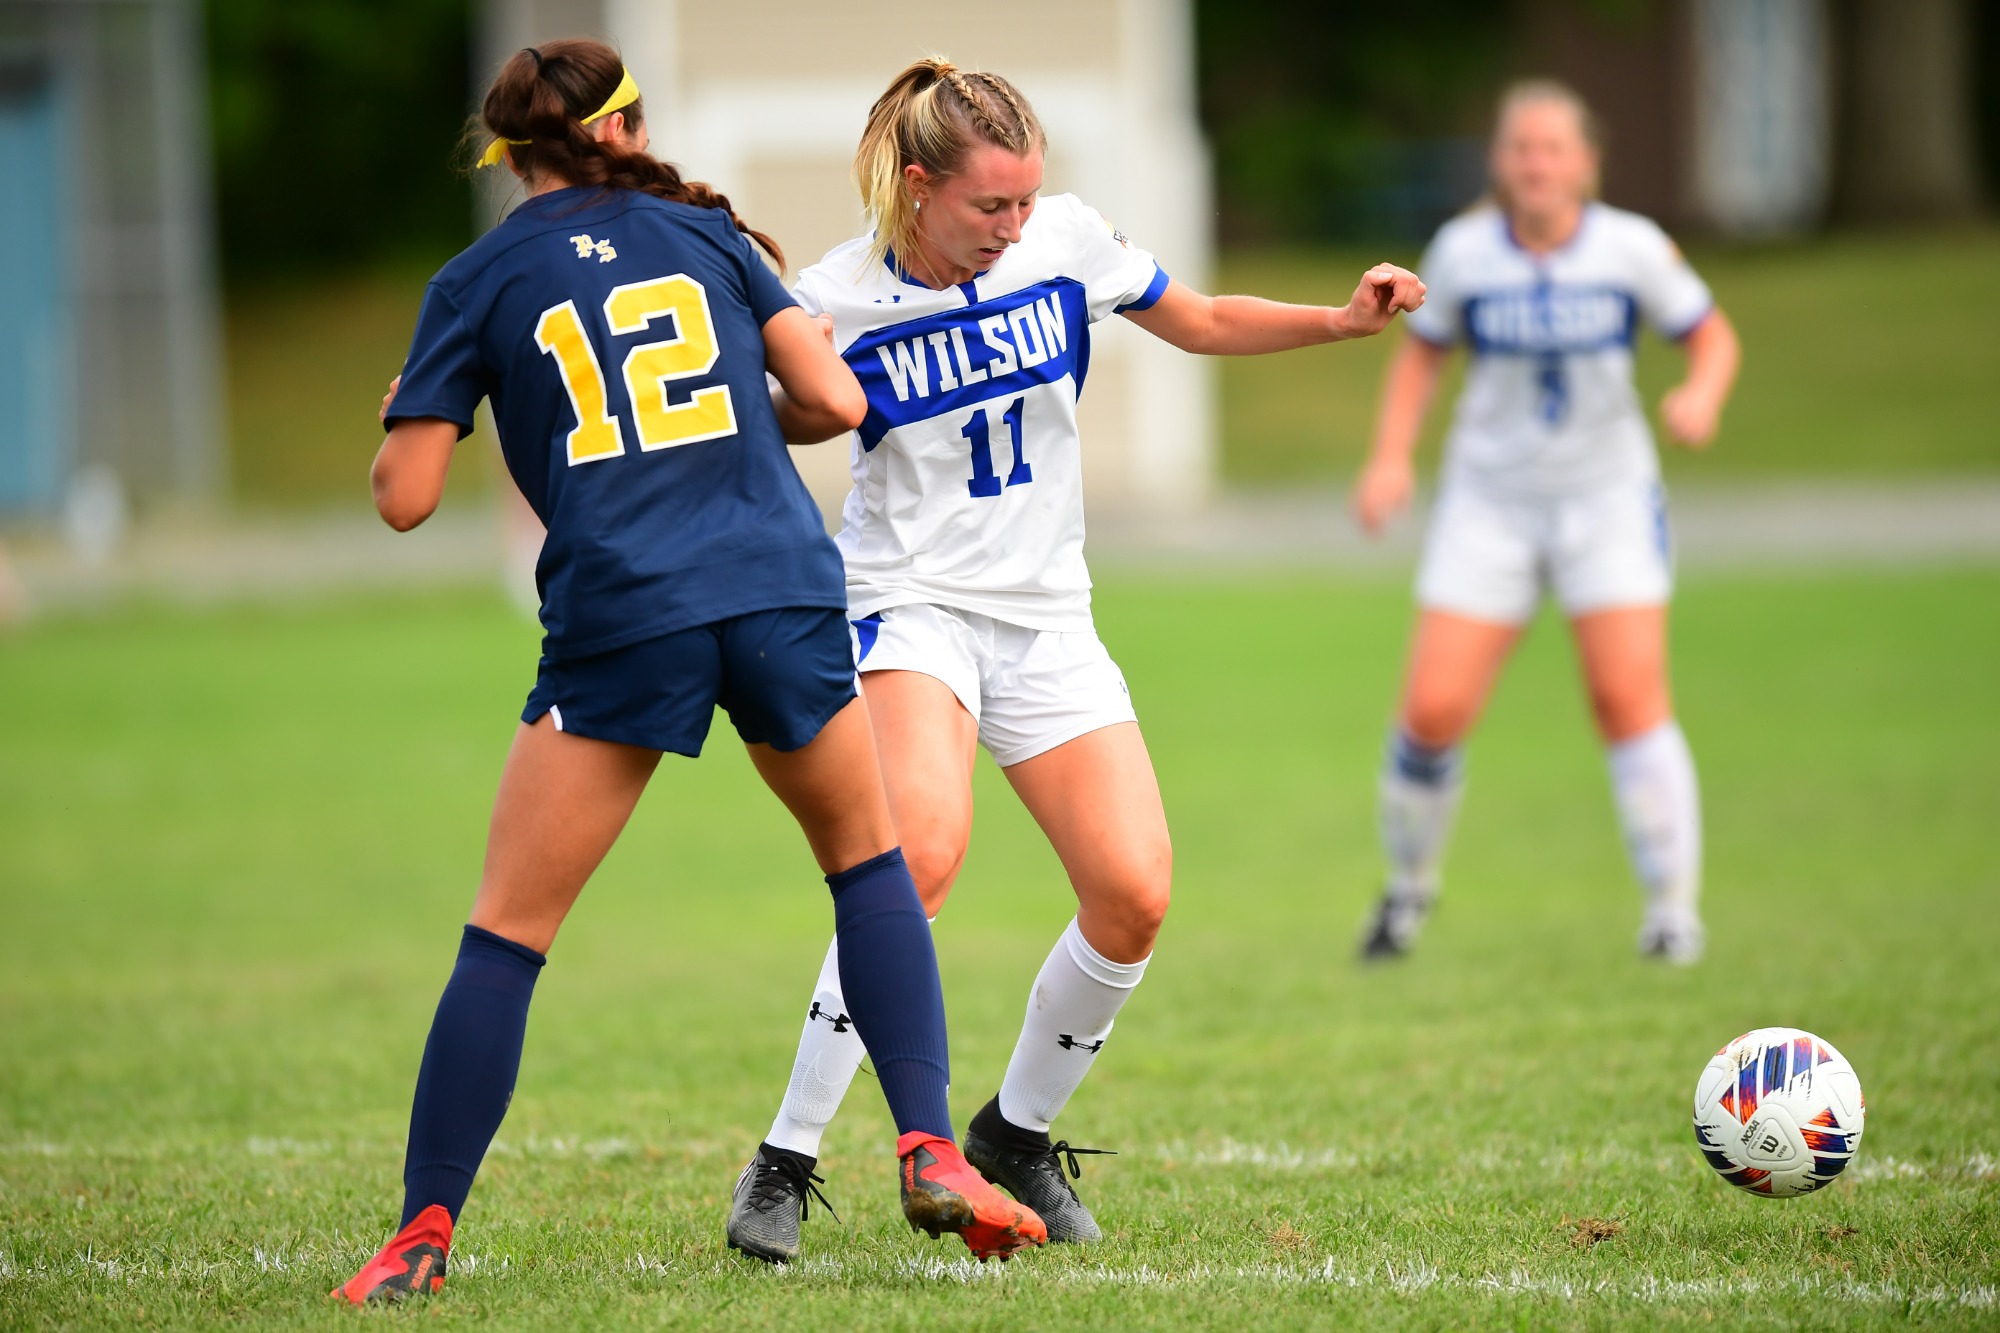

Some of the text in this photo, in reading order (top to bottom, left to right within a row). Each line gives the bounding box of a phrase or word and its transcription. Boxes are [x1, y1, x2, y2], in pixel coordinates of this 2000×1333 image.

[534, 273, 738, 467] 12
[876, 291, 1067, 402] WILSON
[961, 396, 1033, 498] 11
[1740, 1119, 1760, 1146] NCAA
